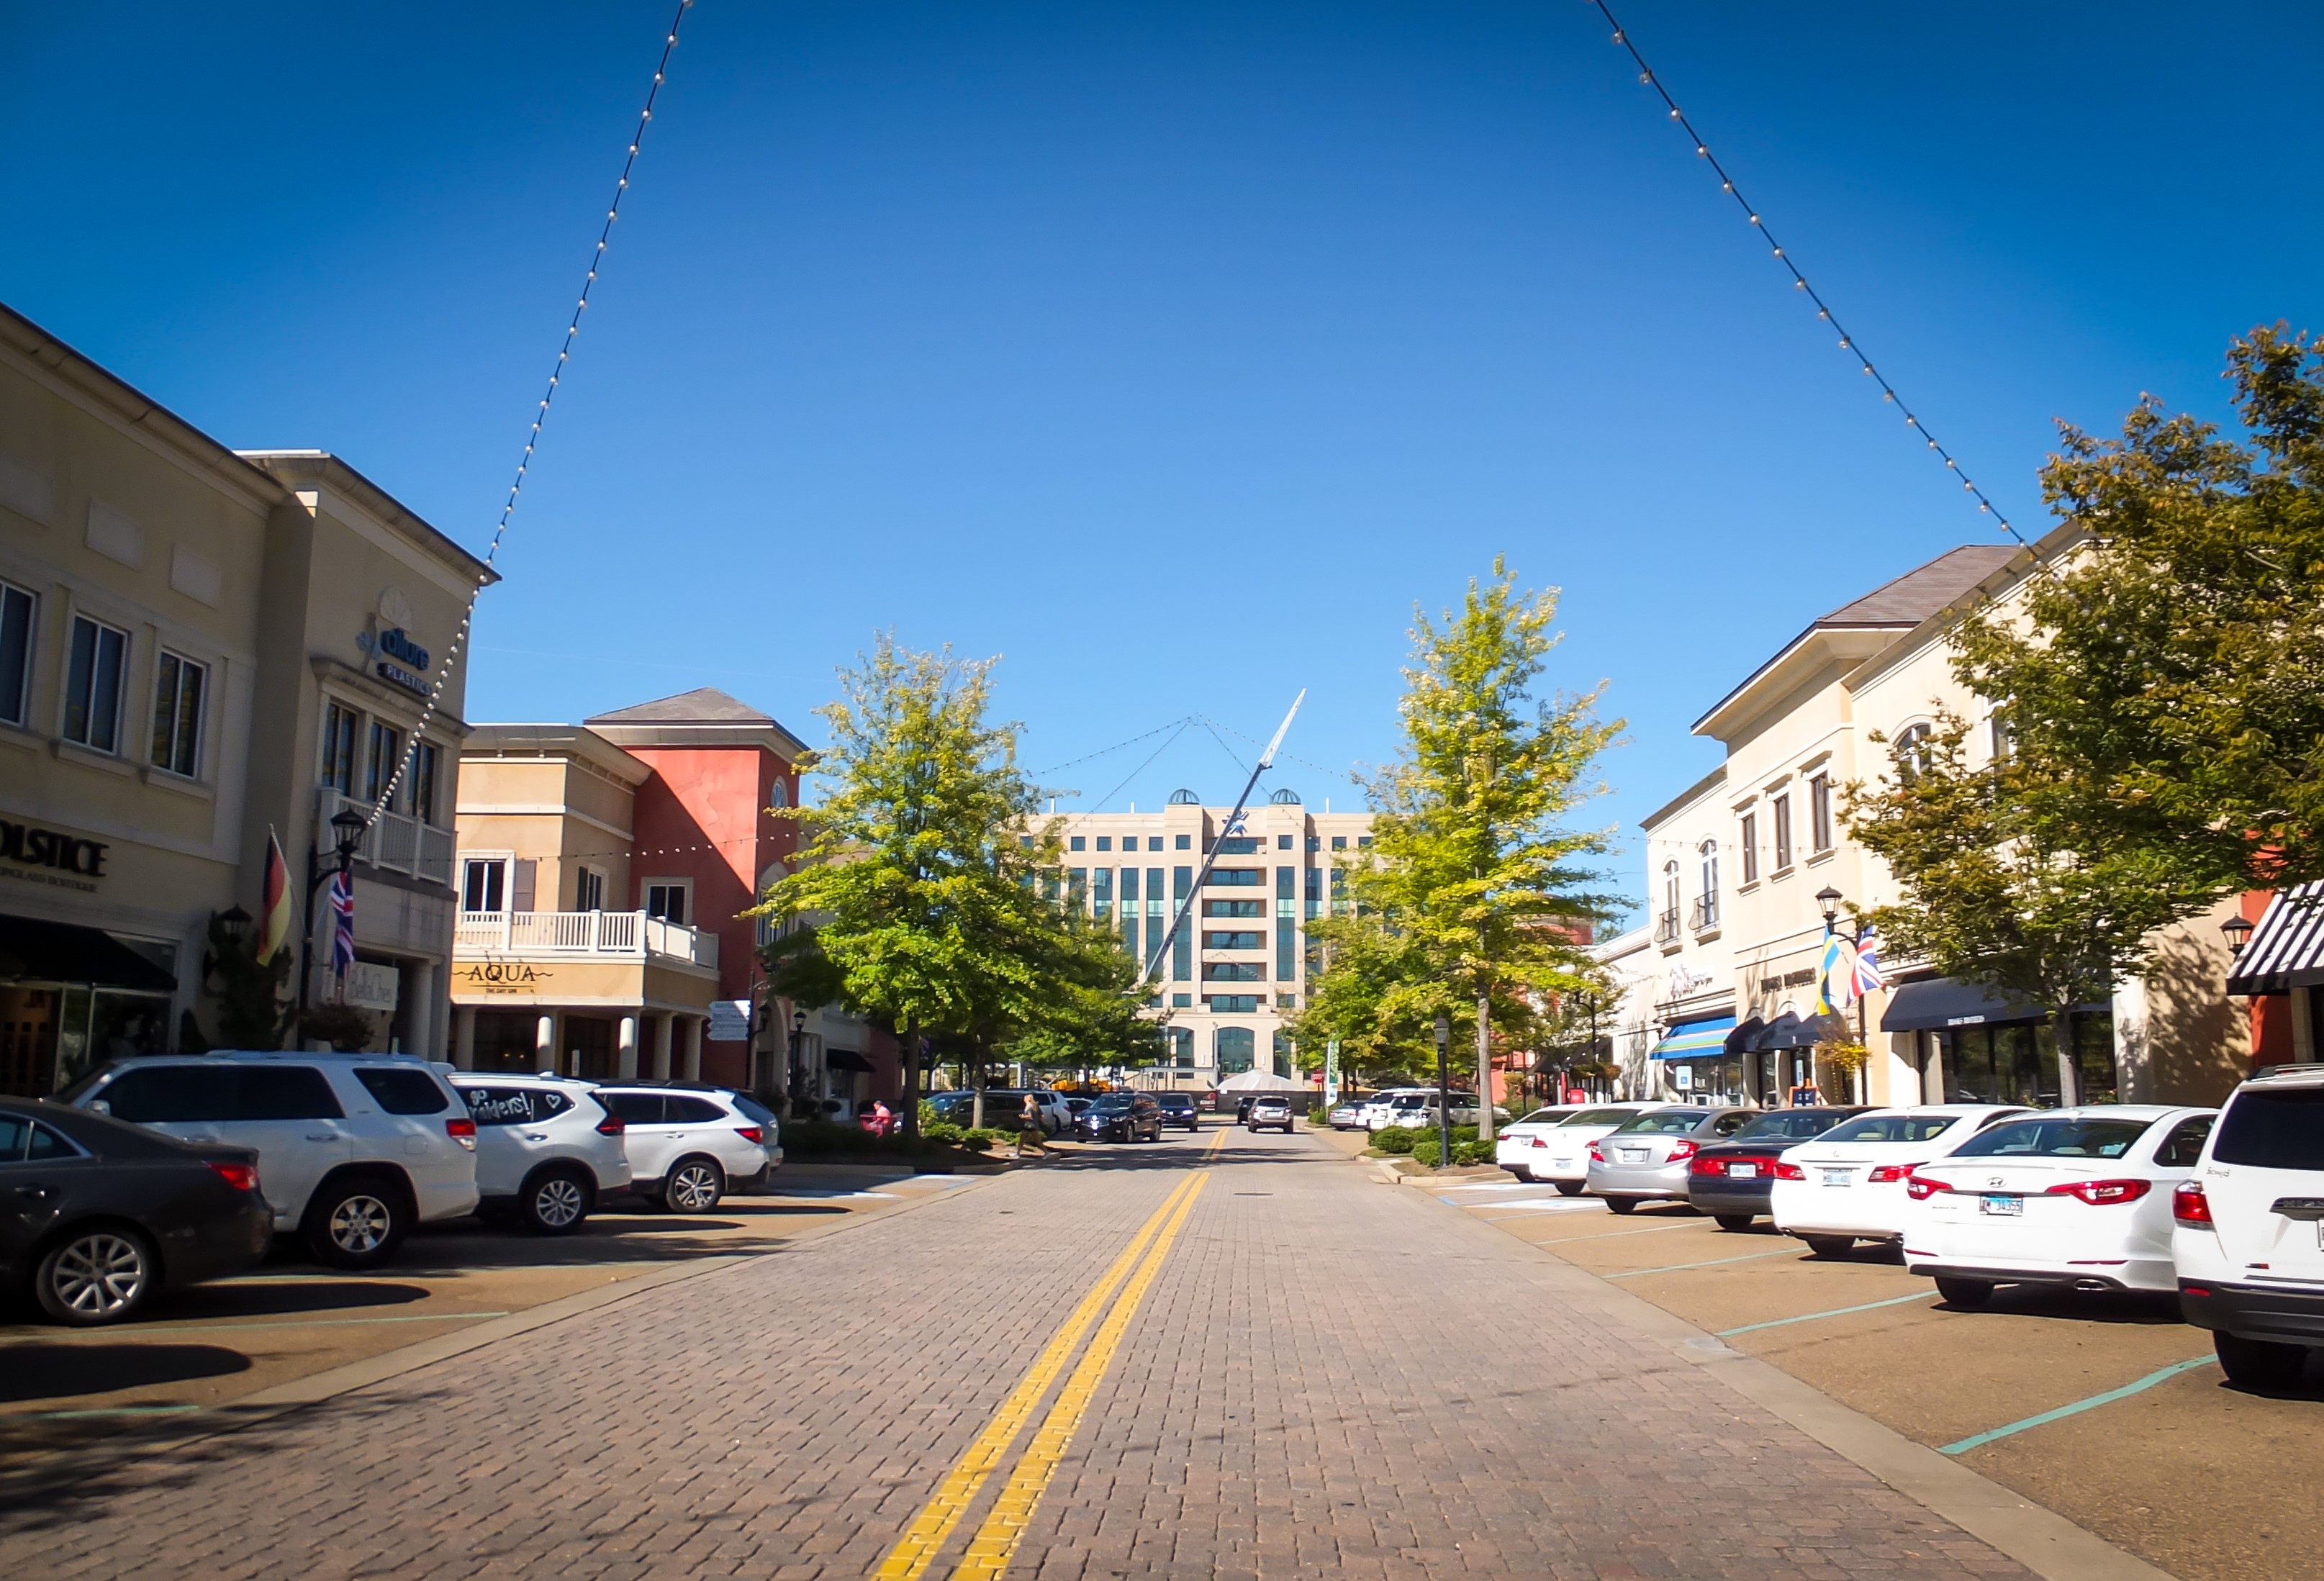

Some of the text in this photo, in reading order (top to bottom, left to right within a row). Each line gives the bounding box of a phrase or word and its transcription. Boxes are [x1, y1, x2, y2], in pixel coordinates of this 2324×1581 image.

[381, 627, 430, 671] allure
[387, 665, 431, 696] PLASTICS
[468, 964, 536, 984] AQUA
[469, 1092, 531, 1119] raiders!
[470, 1090, 487, 1106] go
